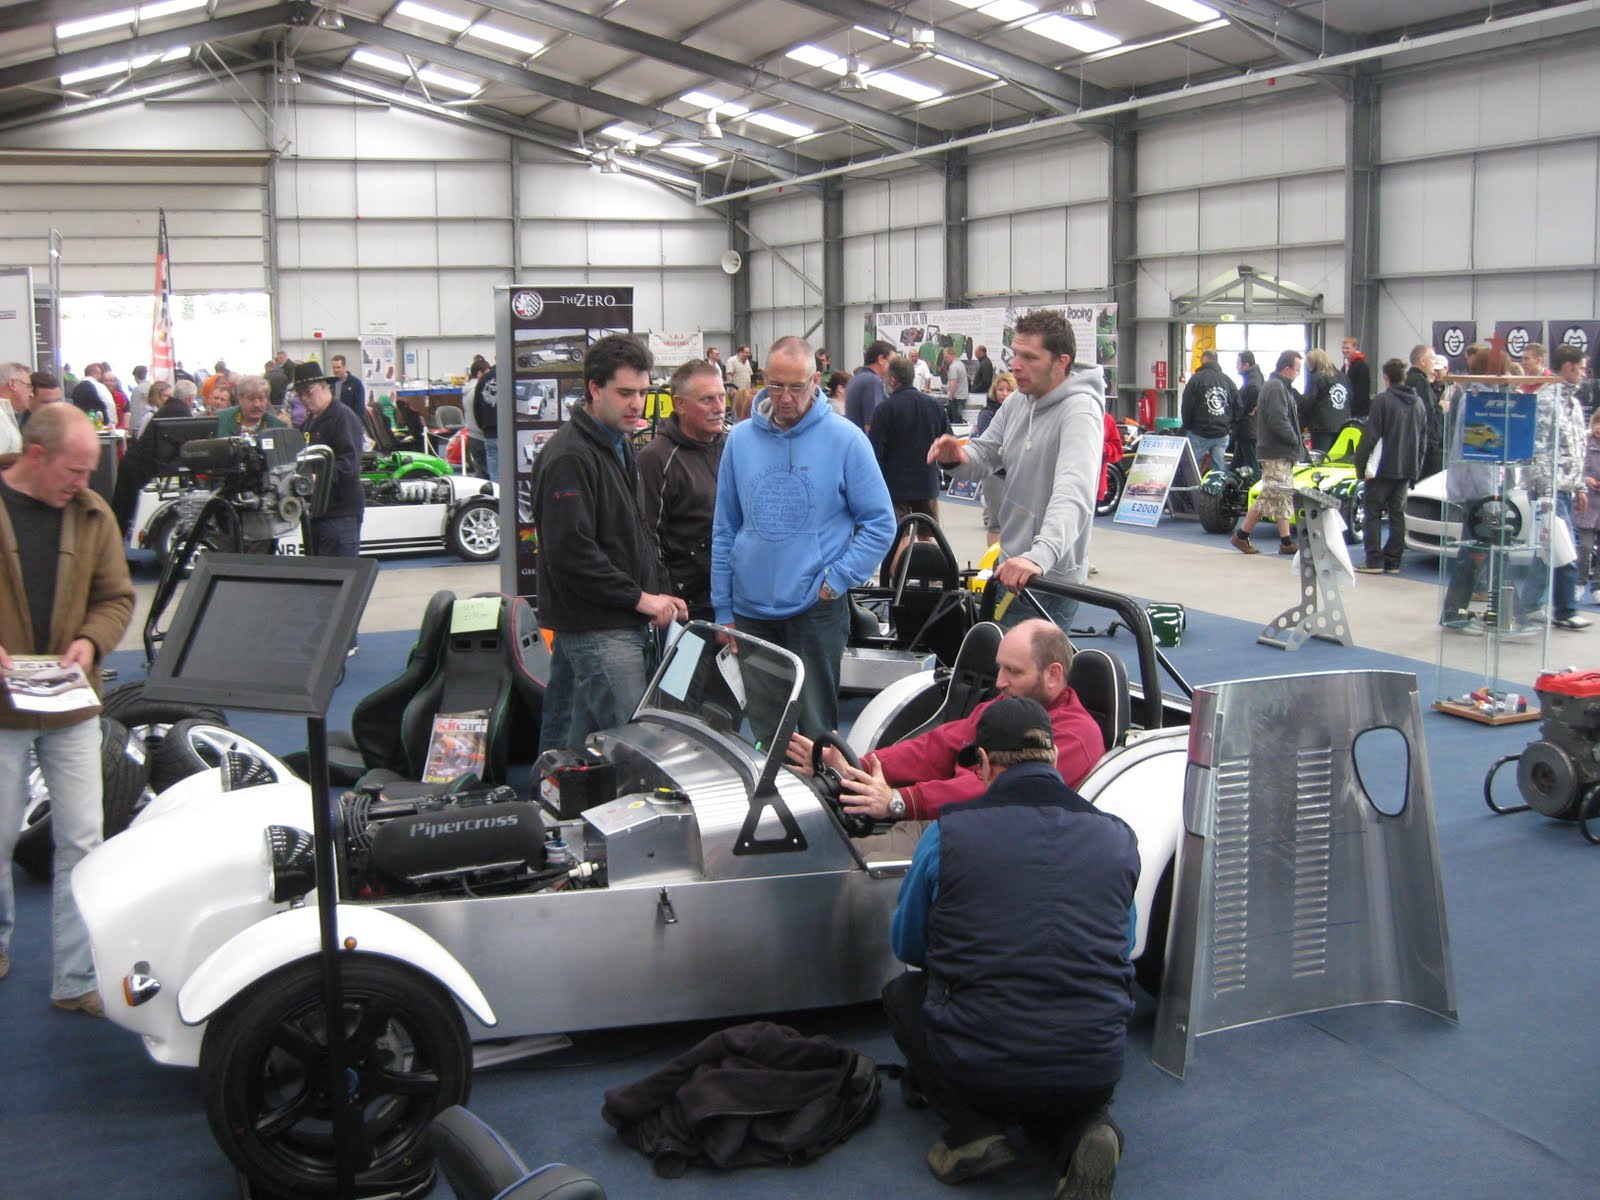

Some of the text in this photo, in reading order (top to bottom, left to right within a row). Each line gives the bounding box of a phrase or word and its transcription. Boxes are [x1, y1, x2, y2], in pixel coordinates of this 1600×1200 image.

[576, 293, 616, 307] ZERO
[1067, 306, 1093, 322] Racing
[1131, 503, 1159, 514] £2000
[410, 815, 519, 838] Pipercross
